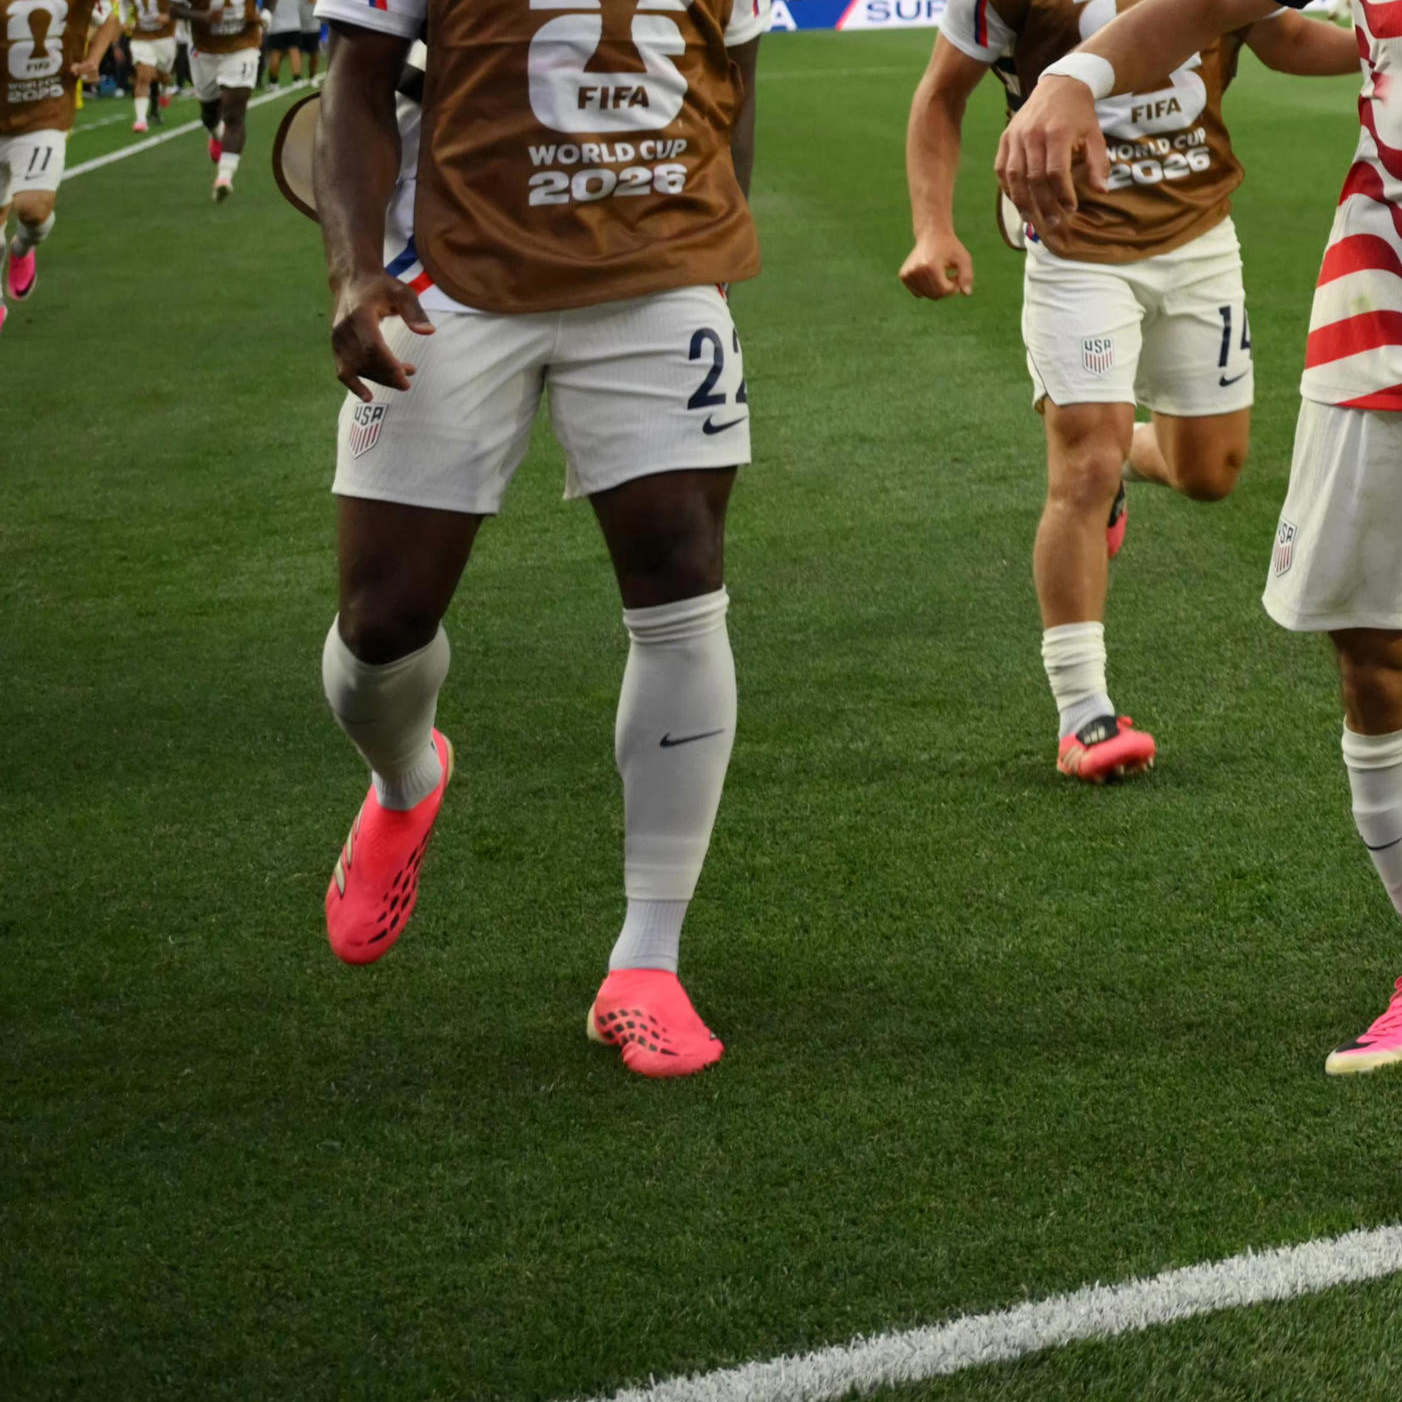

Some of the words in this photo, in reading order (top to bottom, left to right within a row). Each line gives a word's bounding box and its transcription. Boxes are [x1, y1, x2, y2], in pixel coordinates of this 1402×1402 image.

[577, 85, 650, 110] FIFA
[1131, 98, 1182, 125] FIFA
[1174, 126, 1206, 149] CUP
[528, 142, 635, 167] WORLD
[639, 138, 688, 160] CUP
[1106, 147, 1212, 192] 2026
[528, 162, 688, 207] 2026
[1084, 338, 1113, 355] USA
[354, 404, 385, 426] USA
